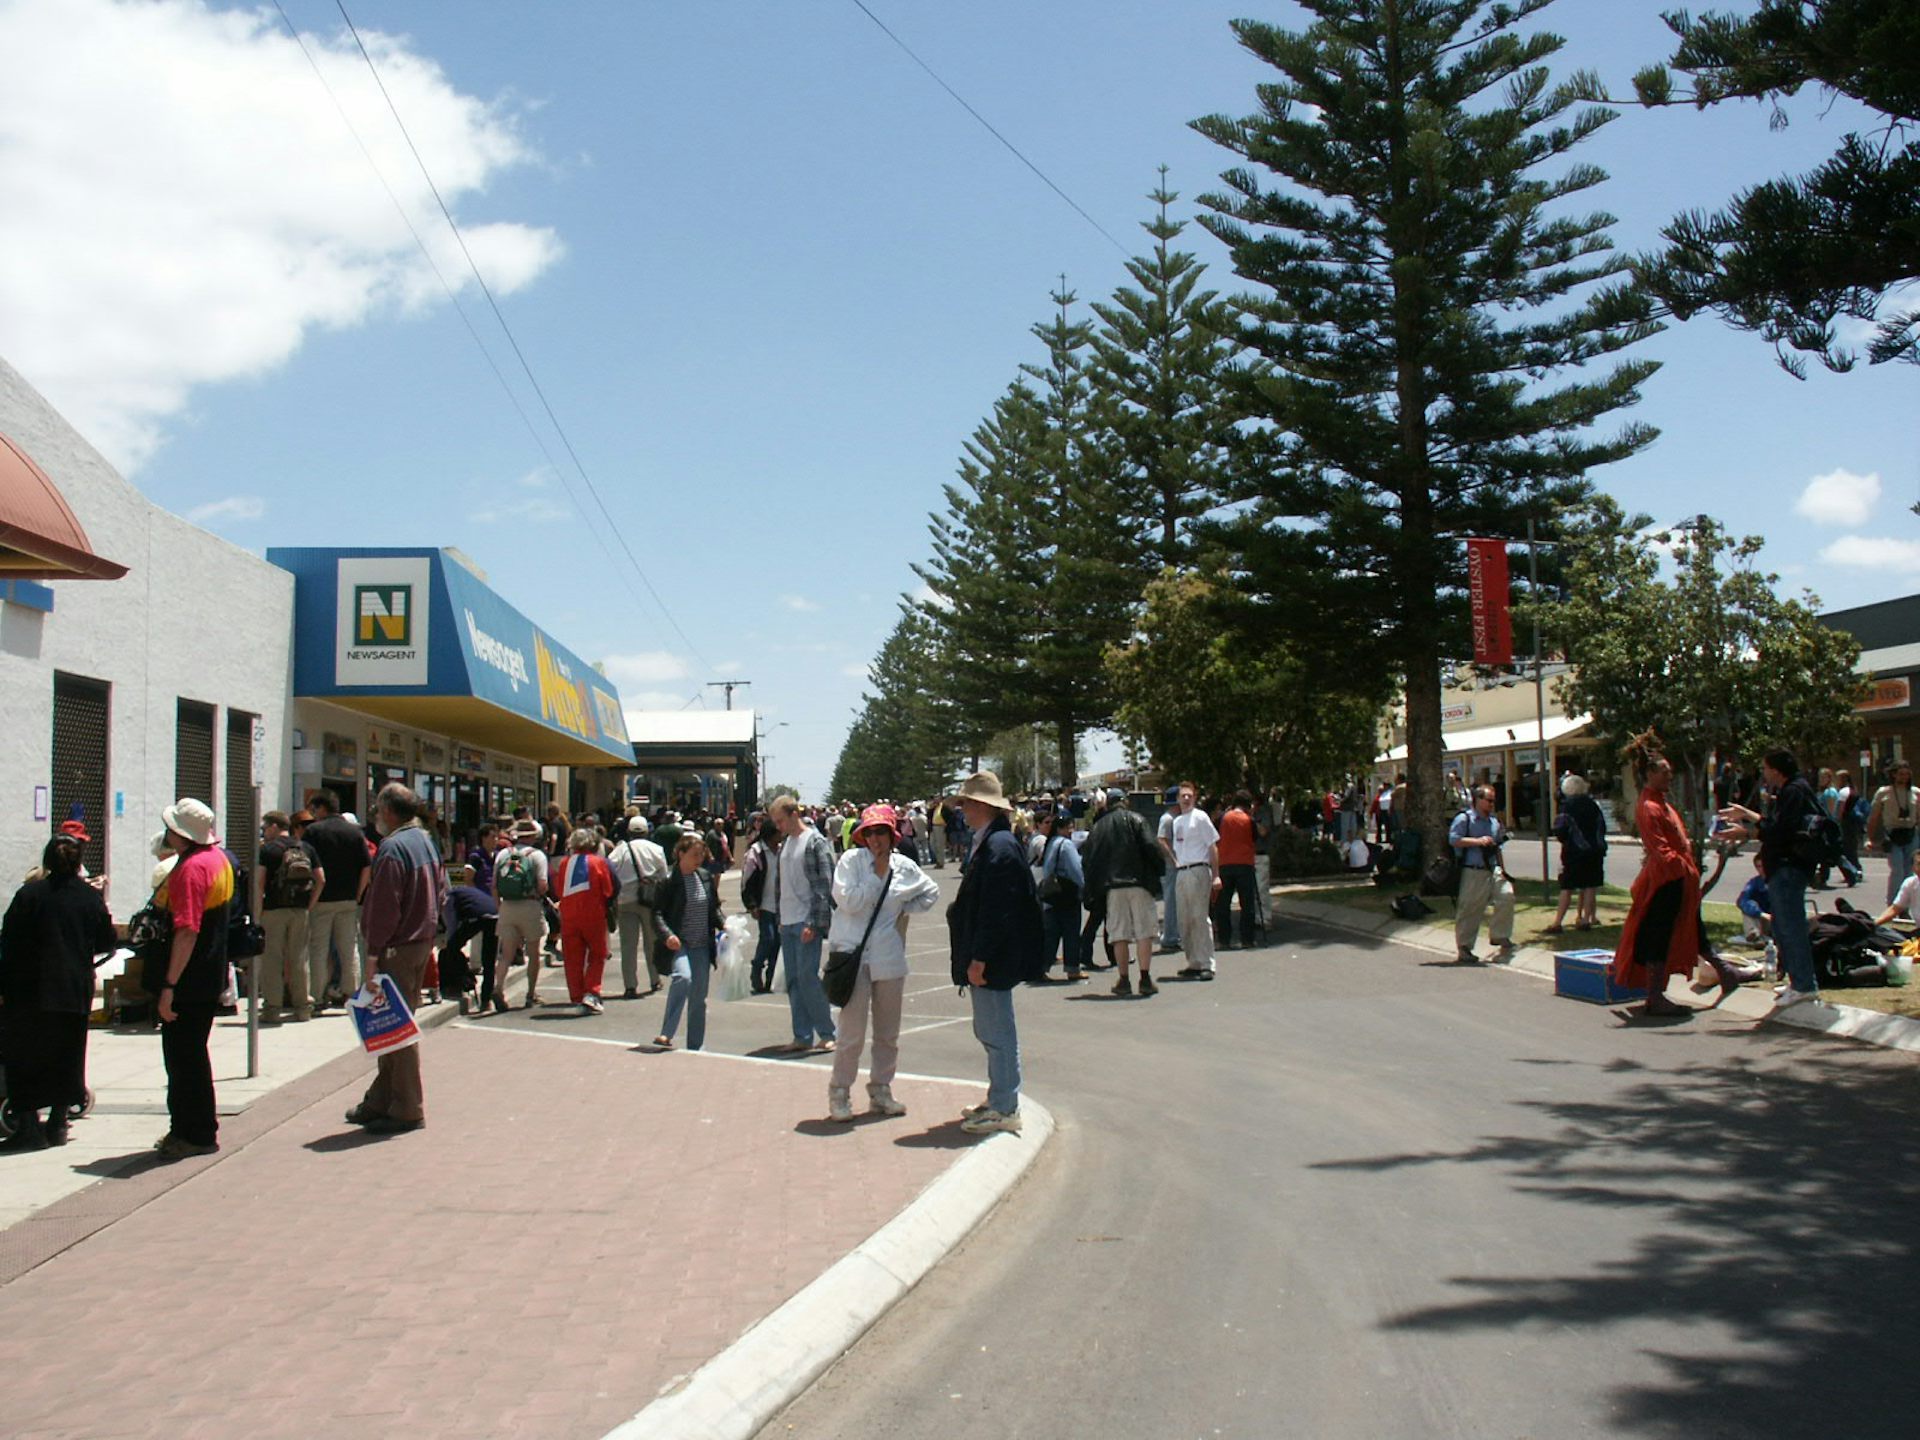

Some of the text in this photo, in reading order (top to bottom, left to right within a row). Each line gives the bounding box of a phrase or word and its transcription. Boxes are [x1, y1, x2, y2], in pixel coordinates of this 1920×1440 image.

[360, 591, 406, 640] N
[1469, 546, 1487, 655] OYSTER FEST
[347, 650, 417, 660] NEWSAGENT
